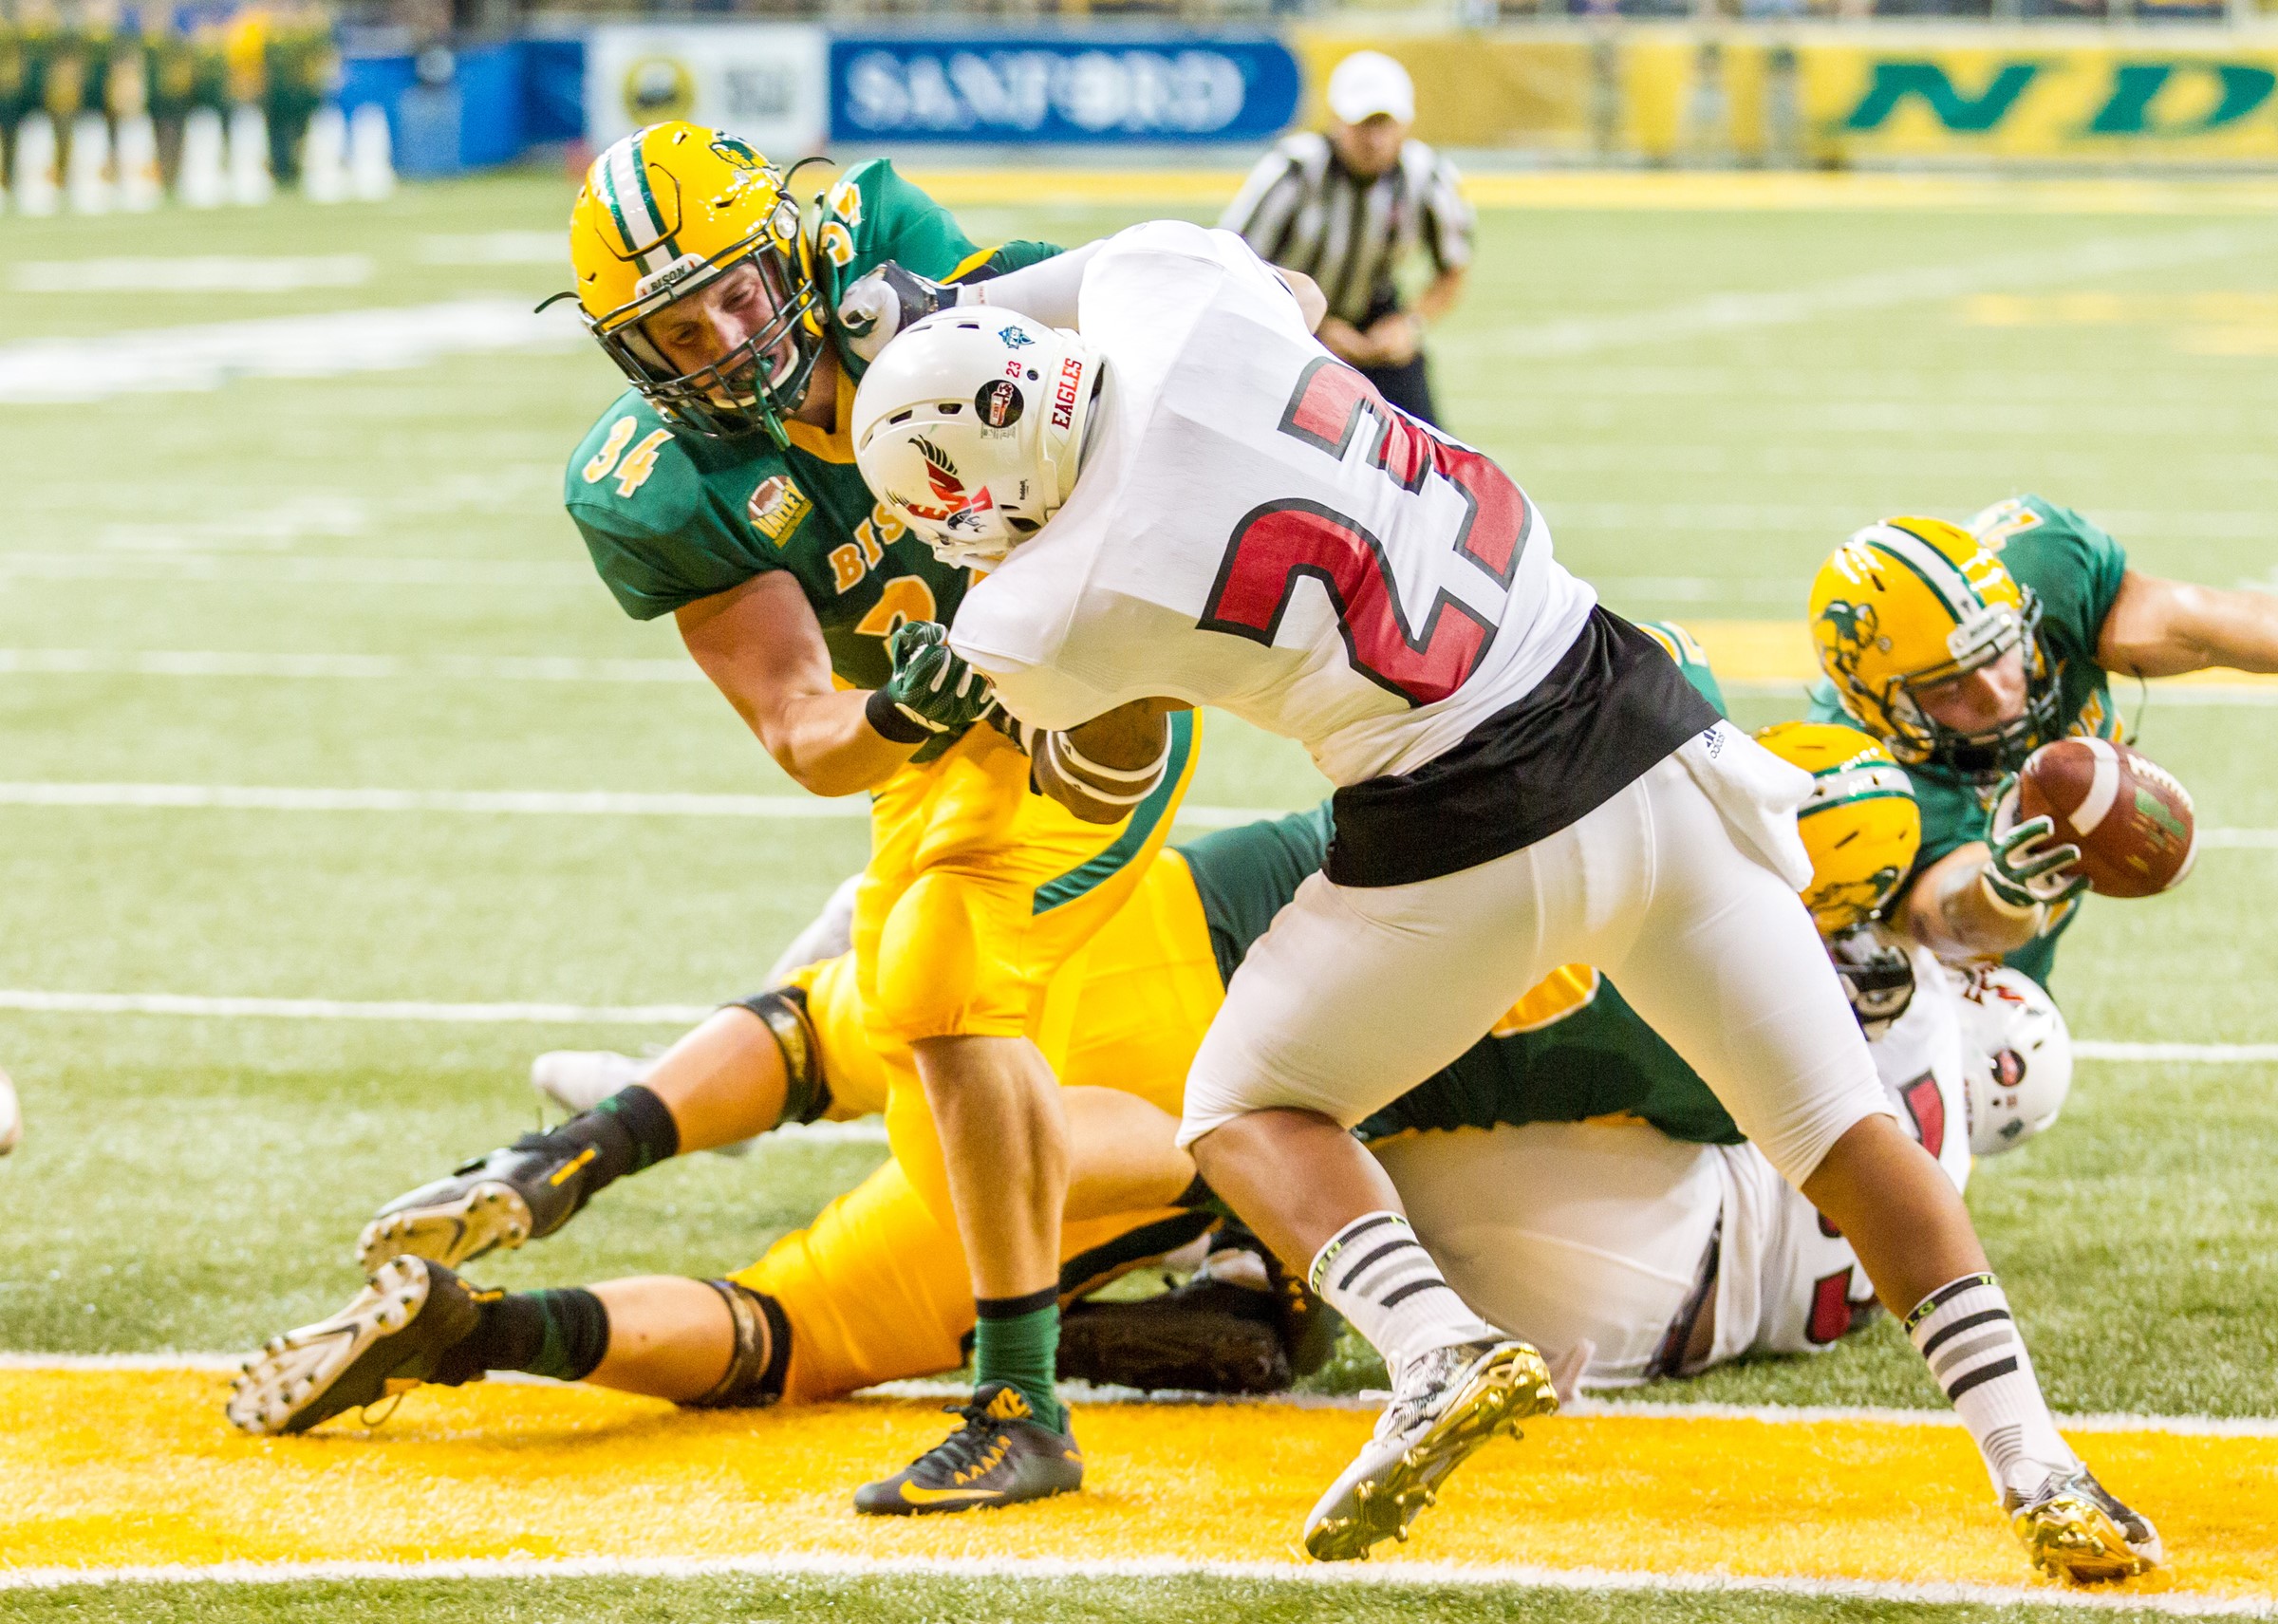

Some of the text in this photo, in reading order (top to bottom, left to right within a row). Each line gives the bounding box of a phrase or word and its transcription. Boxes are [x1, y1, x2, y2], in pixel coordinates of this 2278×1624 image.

[844, 48, 1246, 133] SANFORD
[650, 265, 685, 291] BISON
[1006, 361, 1022, 379] 23
[1051, 357, 1083, 430] EAGLES
[581, 415, 676, 498] 34
[751, 476, 806, 540] VALLEY
[1195, 355, 1532, 708] 23
[827, 501, 907, 595] BIS
